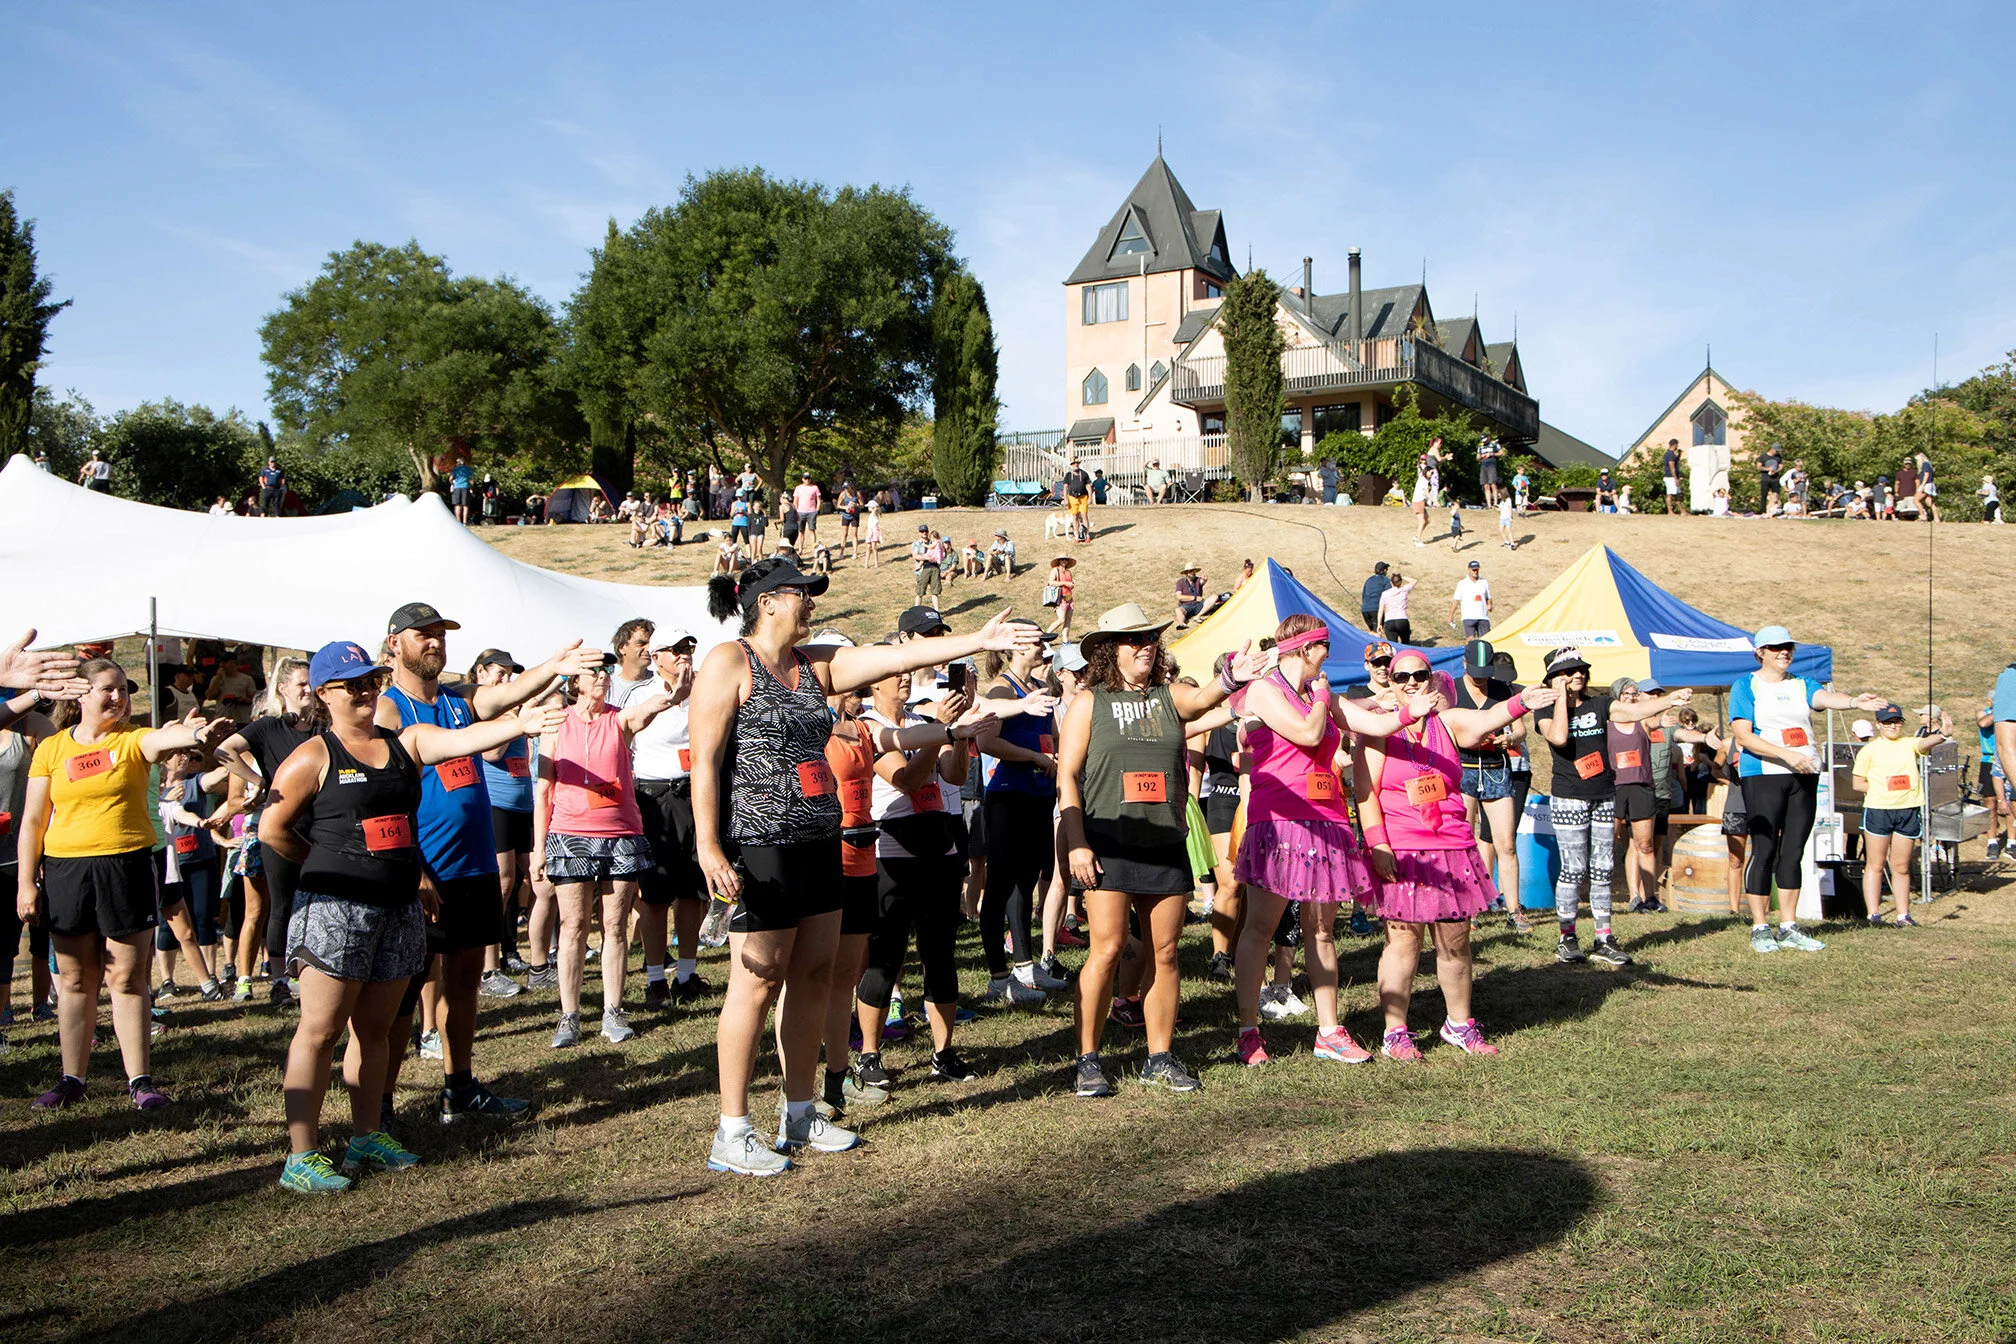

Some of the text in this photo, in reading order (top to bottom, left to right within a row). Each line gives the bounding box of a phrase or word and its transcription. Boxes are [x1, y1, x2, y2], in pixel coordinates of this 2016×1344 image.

[78, 758, 101, 771] 360
[1585, 760, 1600, 770] 092
[452, 765, 471, 778] 413
[811, 771, 828, 784] 393
[1137, 782, 1157, 792] 192
[1317, 781, 1332, 790] 051
[1418, 784, 1437, 795] 504
[379, 826, 402, 838] 164
